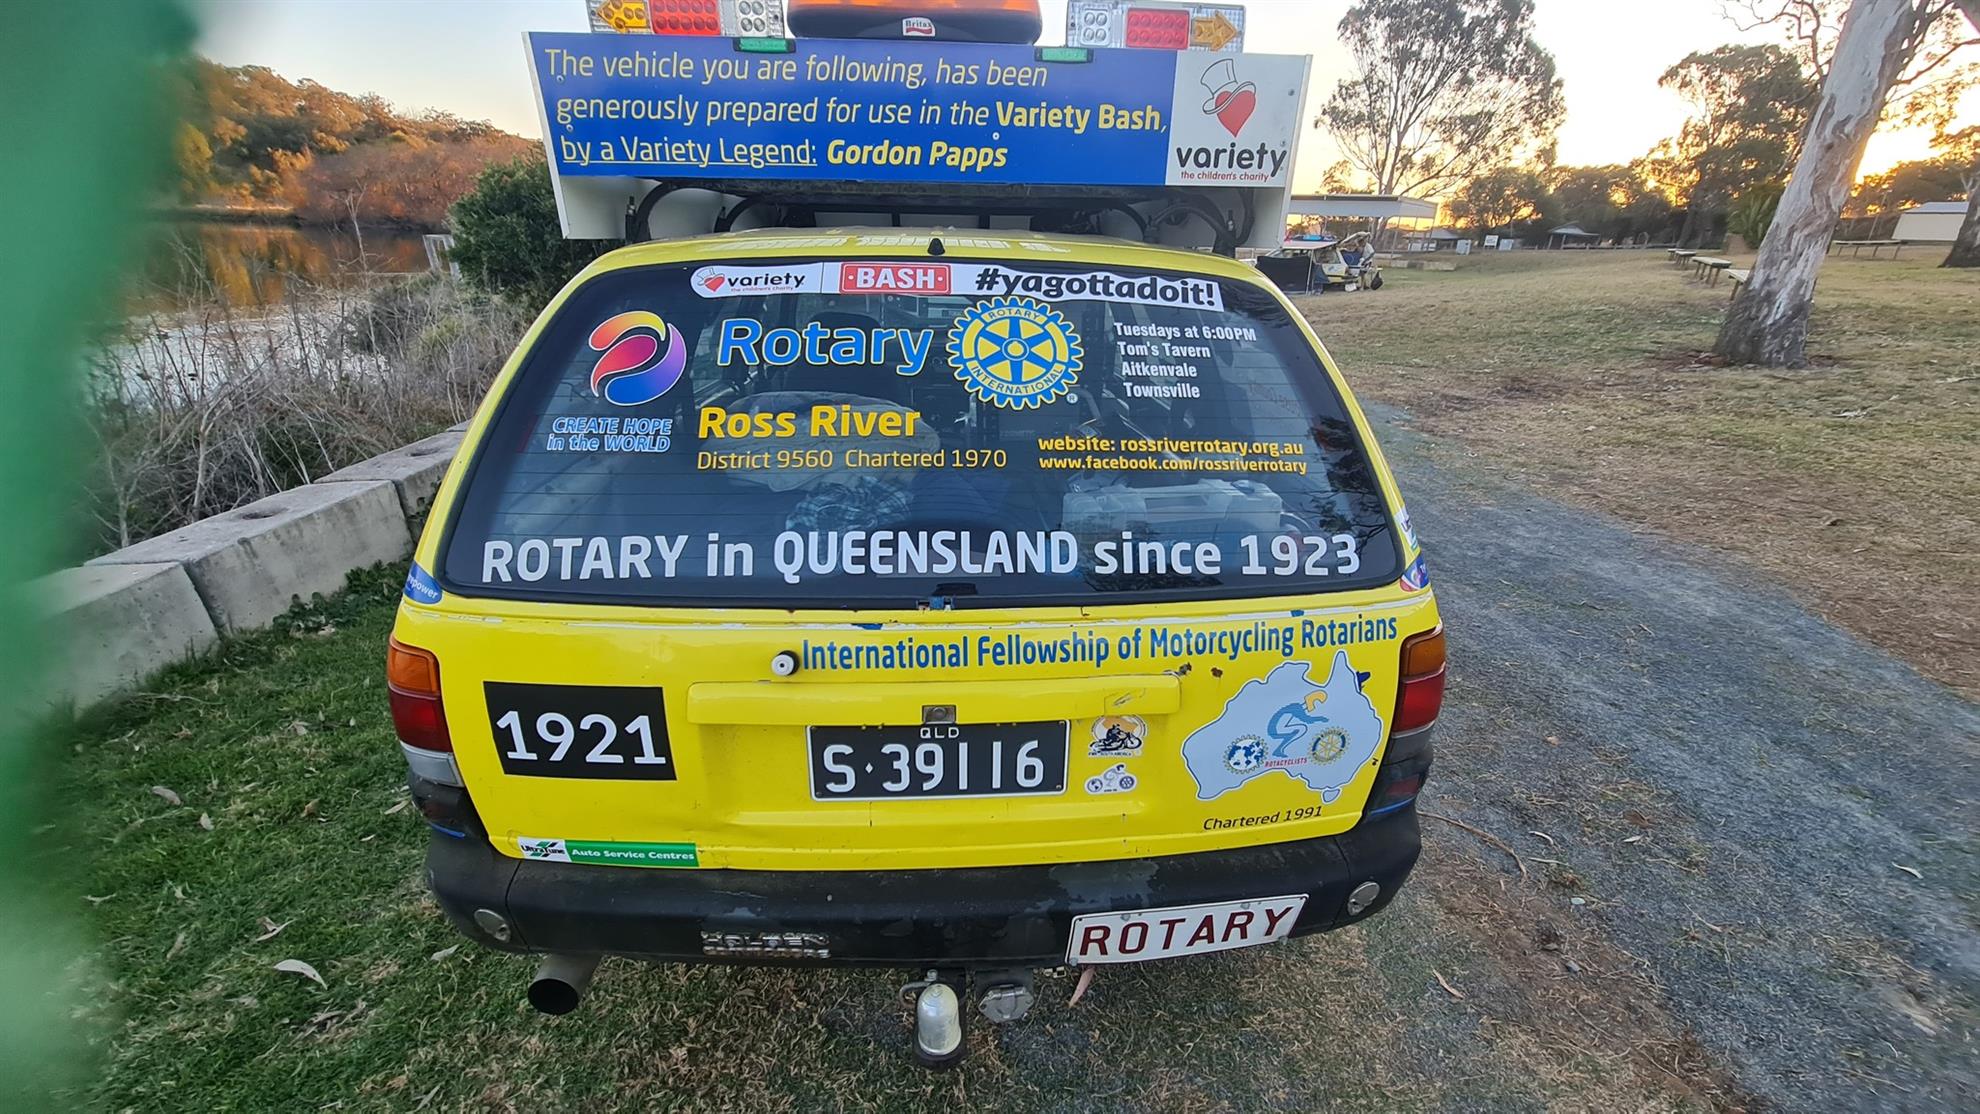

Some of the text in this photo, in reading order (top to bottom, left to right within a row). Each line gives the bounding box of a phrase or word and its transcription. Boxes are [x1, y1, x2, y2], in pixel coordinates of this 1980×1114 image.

[904, 19, 932, 29] Britax
[545, 48, 1047, 88] The vehicle you are following, has been
[556, 95, 1167, 134] generously prepared for use in the Variety Bash,
[560, 136, 1007, 172] by a Variety Legend: Gordon Papps
[1176, 142, 1288, 177] variety
[1181, 171, 1269, 183] the children's charity
[727, 272, 806, 288] variety
[856, 267, 935, 289] BASH
[976, 268, 1215, 307] #yagottadoit!
[987, 307, 1041, 322] ROTARY
[1114, 322, 1257, 342] Tuesdays at 6:00PM
[717, 318, 933, 376] Rotary
[1117, 342, 1211, 358] Tom's Tavern
[1122, 361, 1197, 377] Aitkenvale
[971, 364, 1063, 395] INTERNATIONAL
[1124, 382, 1200, 398] Townsville
[552, 417, 672, 435] CREATE HOPE
[698, 404, 921, 438] Ross River
[547, 434, 671, 453] in the WORLD
[1038, 437, 1303, 456] website: rossriverrotary.org.au
[697, 449, 1007, 469] District 9560 Chartered 1970
[1039, 456, 1307, 475] www.facebook.com/rossriverrotary
[481, 530, 1361, 584] ROTARY in QUEENSLAND since 1923
[802, 614, 1398, 671] International Fellowship of Motorcycling Rotarians
[496, 710, 667, 765] 1921
[920, 726, 960, 740] QLD
[1264, 757, 1308, 767] ROTACYCLISTS
[1203, 805, 1323, 831] Chartered 1991
[572, 848, 695, 860] Auto Service Centres
[1079, 905, 1293, 956] ROTARY
